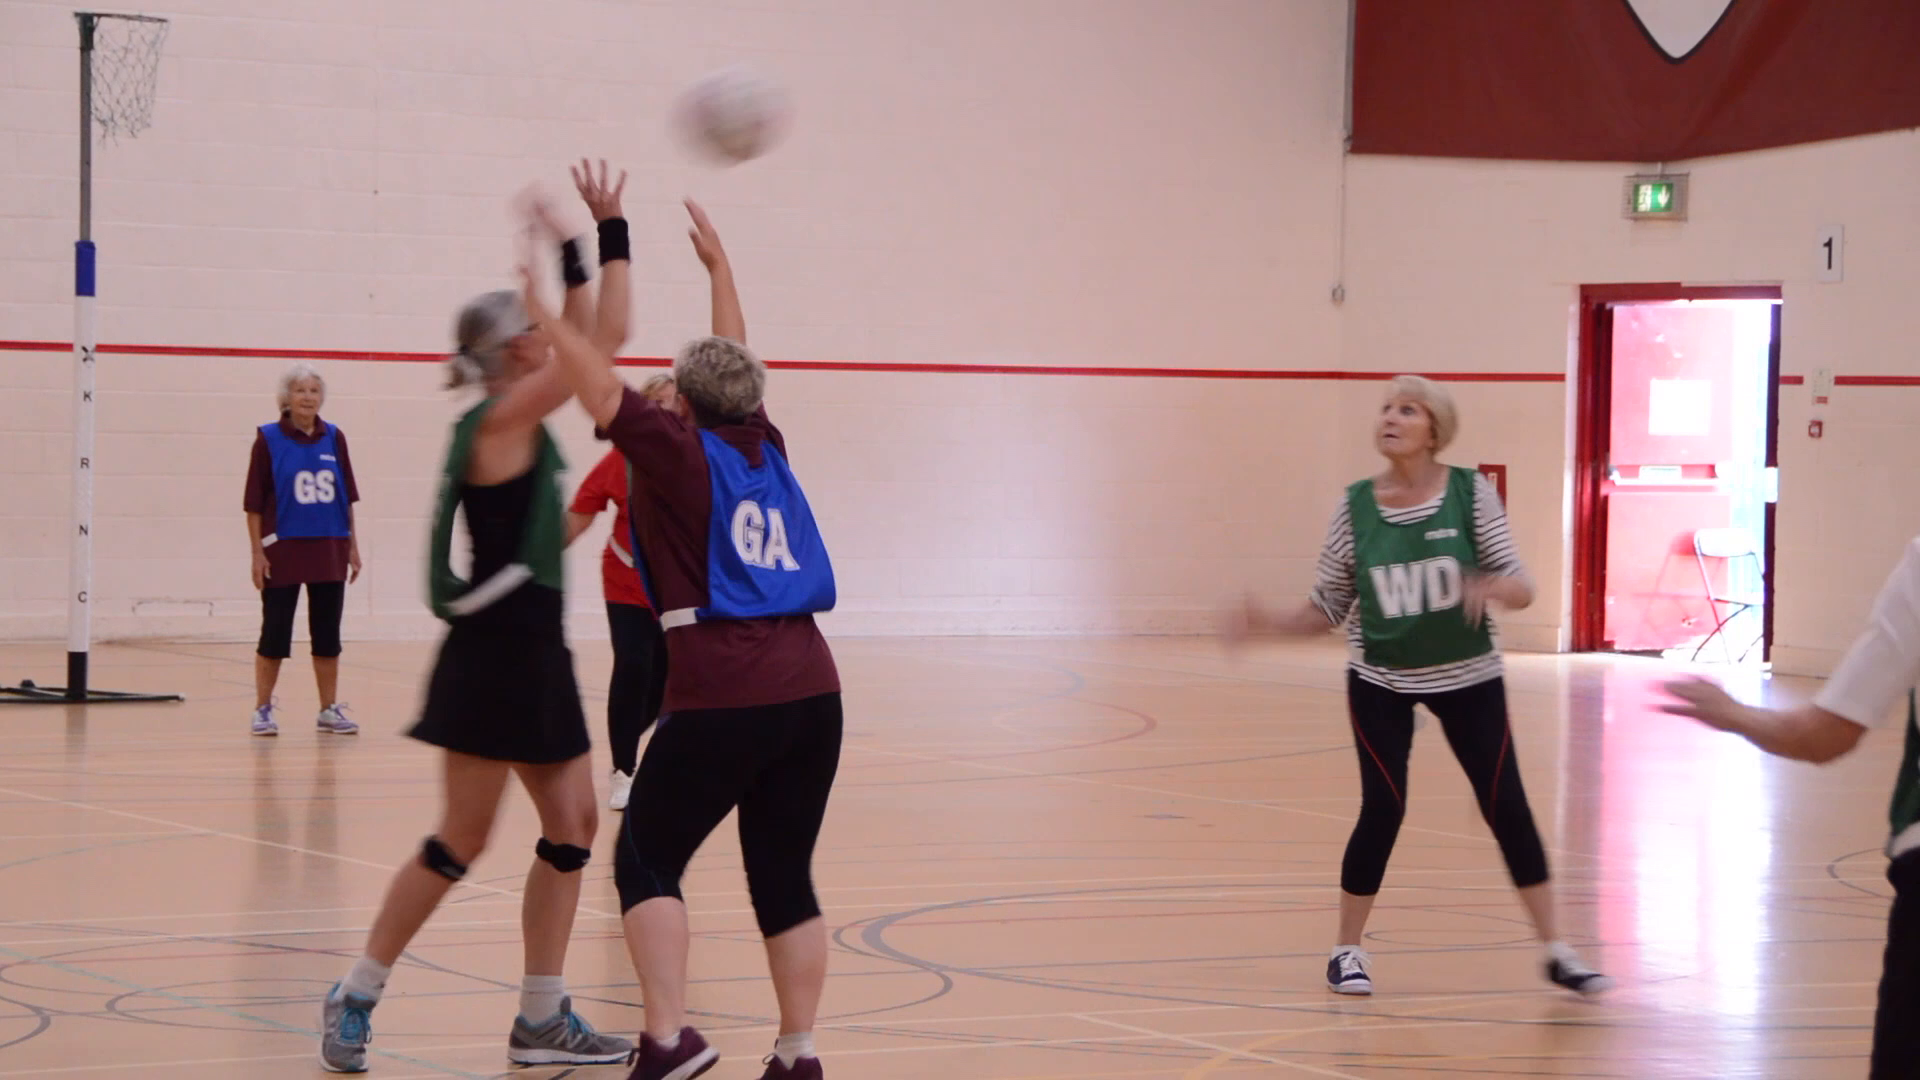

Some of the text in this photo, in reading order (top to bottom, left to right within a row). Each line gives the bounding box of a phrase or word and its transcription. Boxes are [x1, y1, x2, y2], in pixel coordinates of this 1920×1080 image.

[1822, 236, 1833, 270] 1
[294, 469, 335, 504] GS
[731, 500, 800, 571] GA
[1368, 556, 1461, 619] WD
